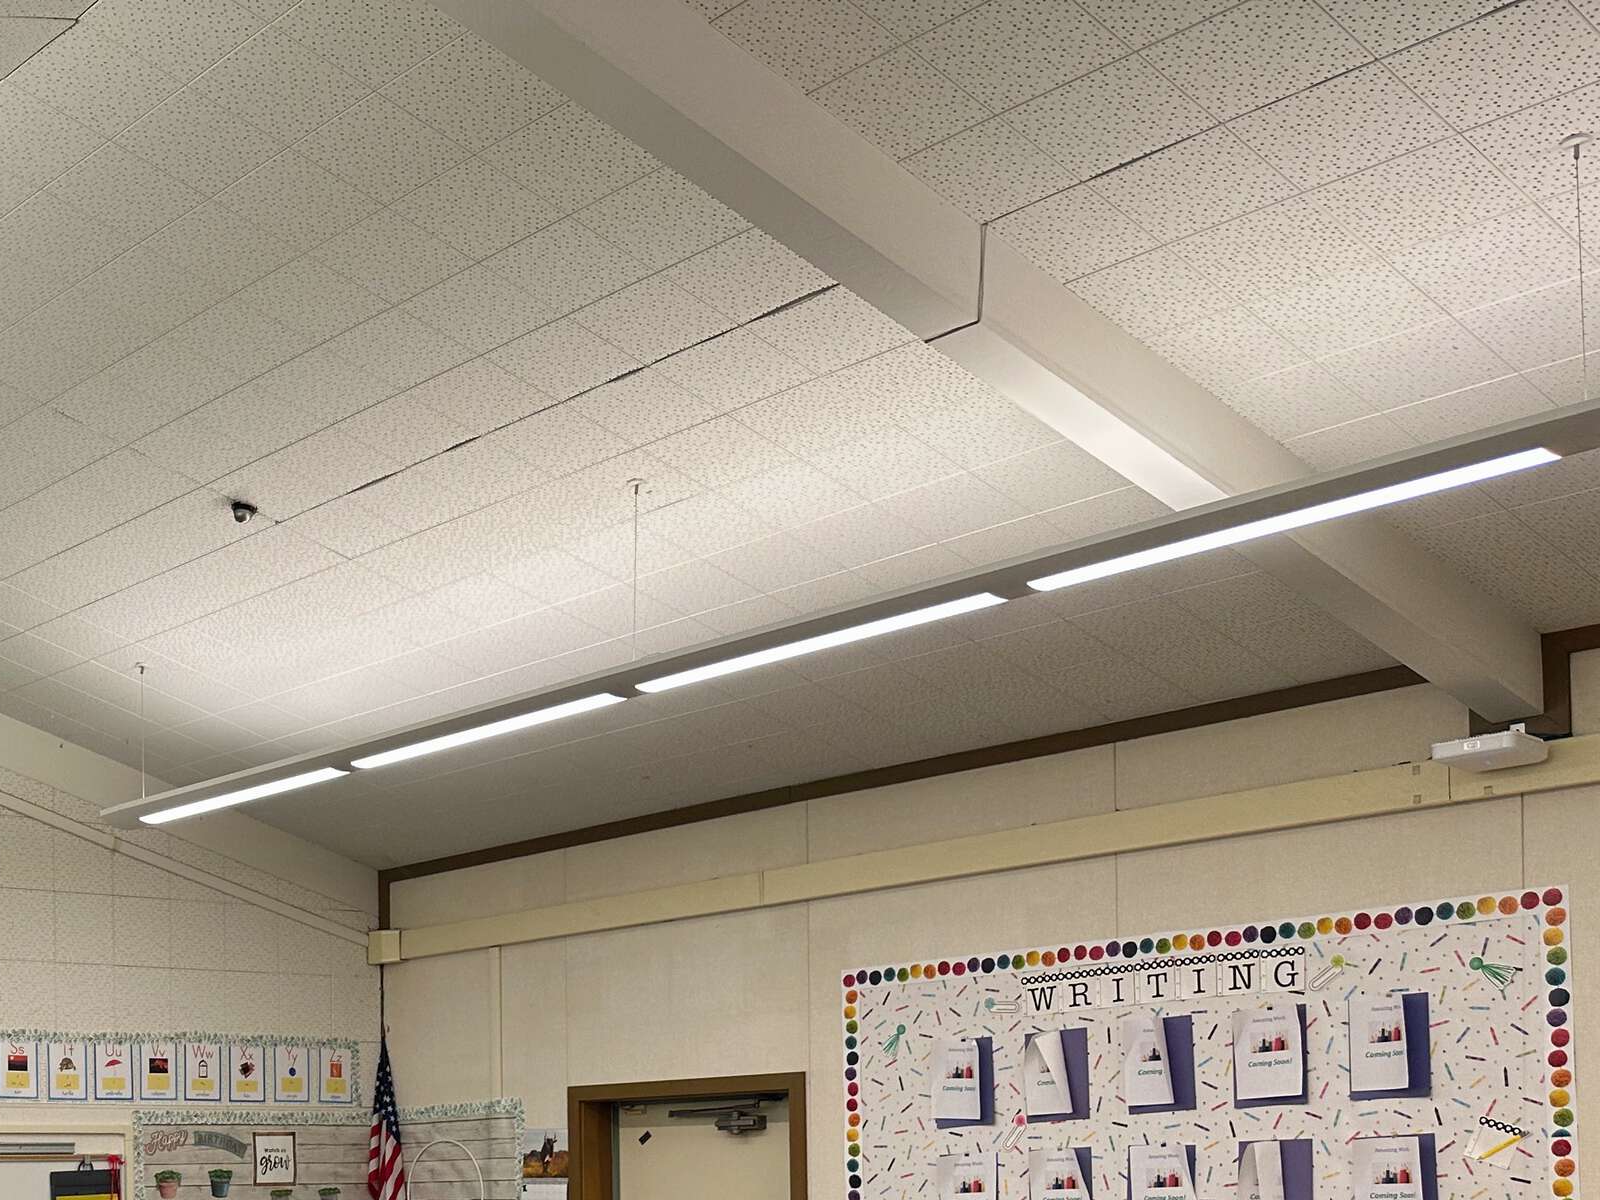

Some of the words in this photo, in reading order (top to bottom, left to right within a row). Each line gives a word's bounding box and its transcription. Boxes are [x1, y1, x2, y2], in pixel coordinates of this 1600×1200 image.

[1027, 960, 1299, 1011] WRITING
[192, 1047, 214, 1059] Ww
[240, 1048, 254, 1061] Xx
[285, 1049, 298, 1066] Yy
[1248, 1060, 1274, 1069] Coming
[147, 1130, 189, 1156] Happy
[260, 1155, 292, 1175] grow
[1369, 1192, 1398, 1200] Coming
